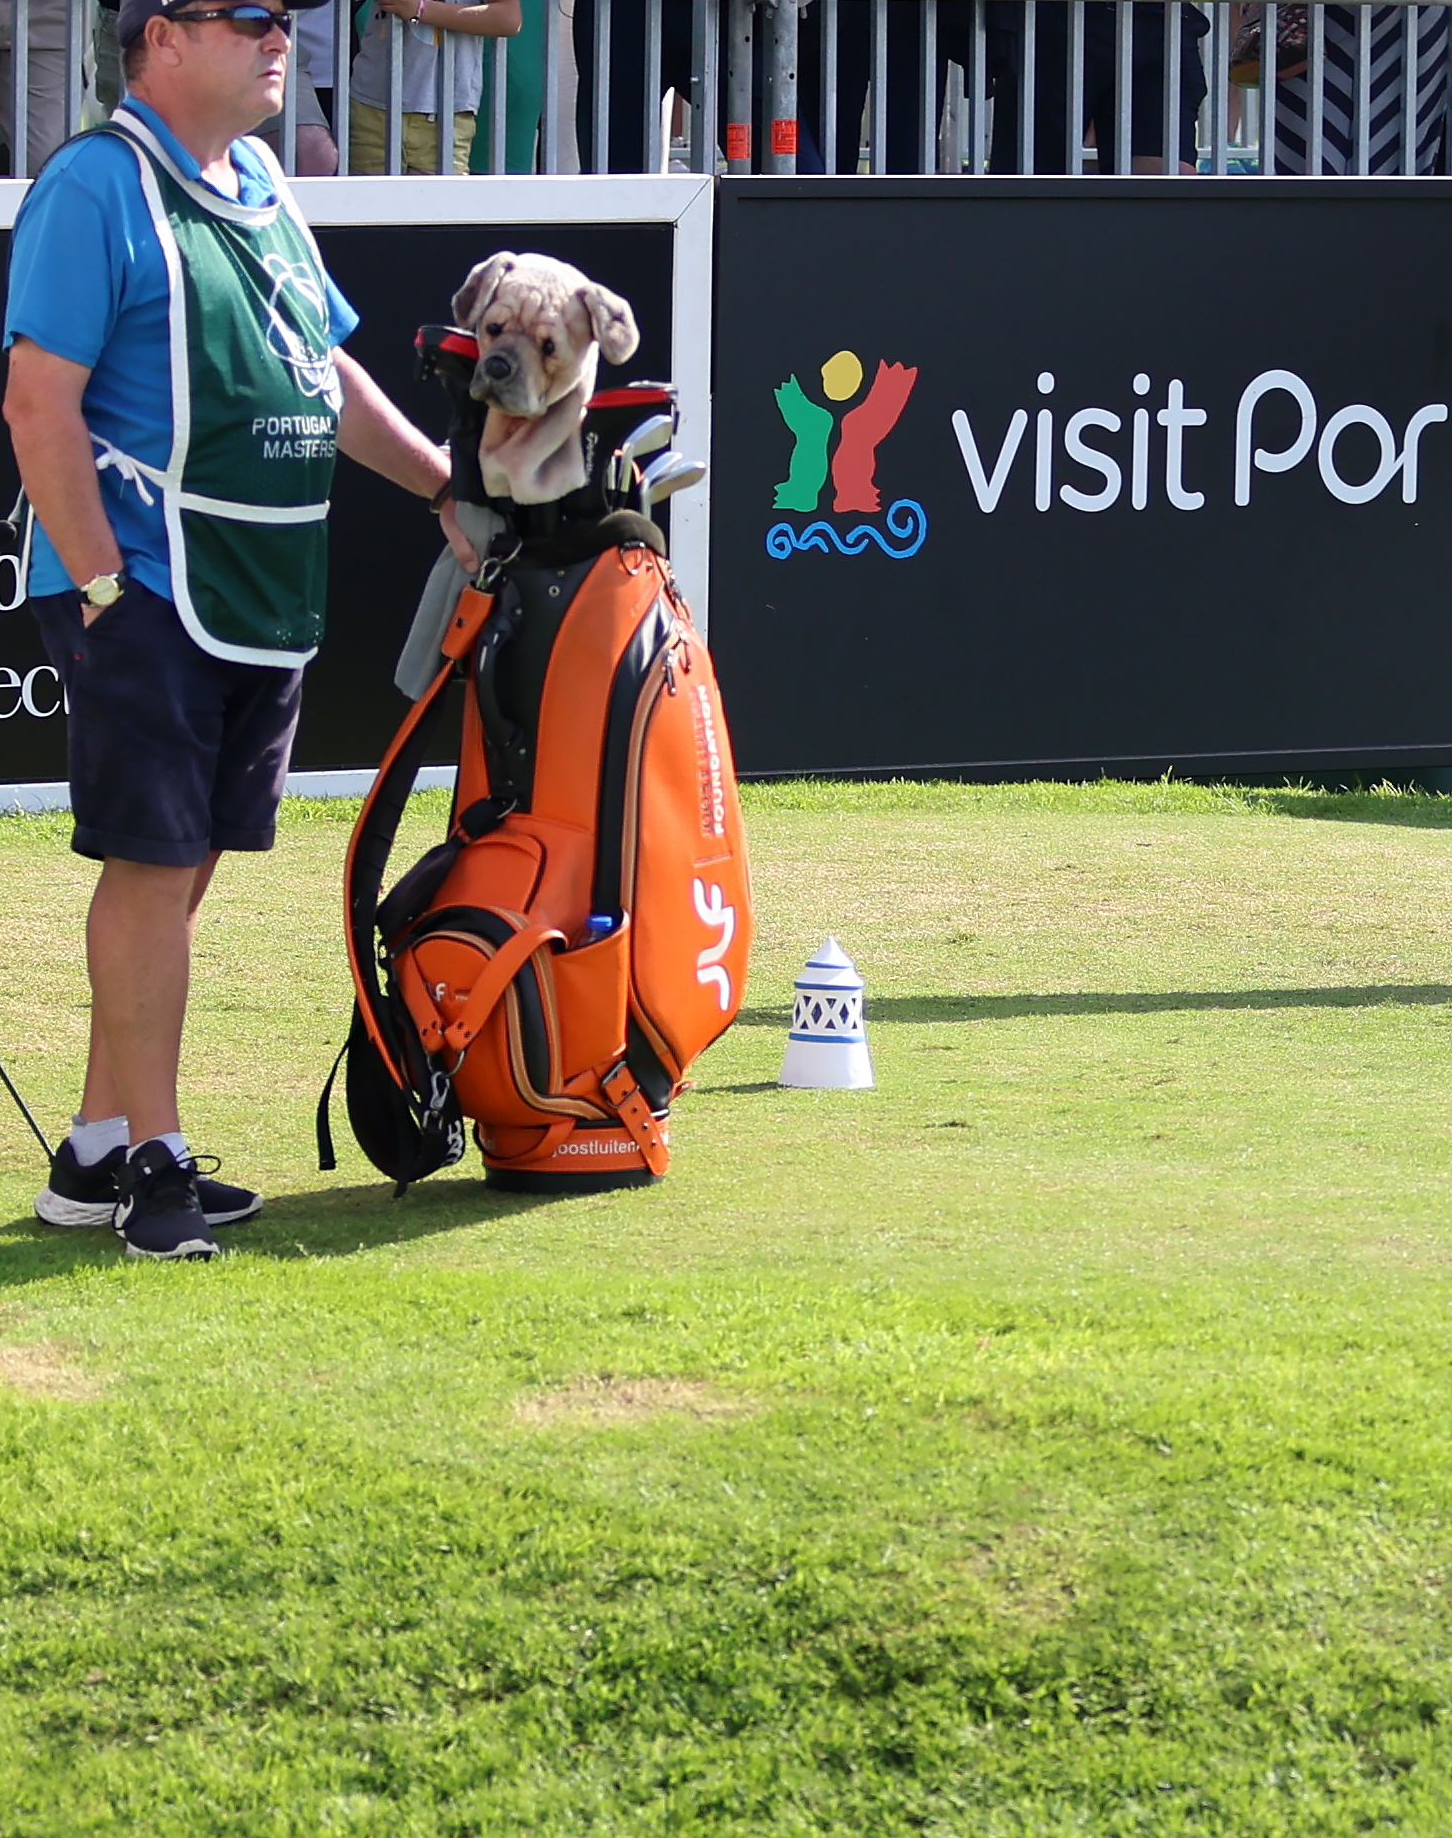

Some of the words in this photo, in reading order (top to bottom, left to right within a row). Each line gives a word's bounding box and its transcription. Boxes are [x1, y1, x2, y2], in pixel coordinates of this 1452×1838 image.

[252, 416, 335, 436] PORTUGAL
[263, 440, 336, 460] MASTERS
[952, 371, 1207, 513] visit
[698, 685, 725, 836] FOUNDATION
